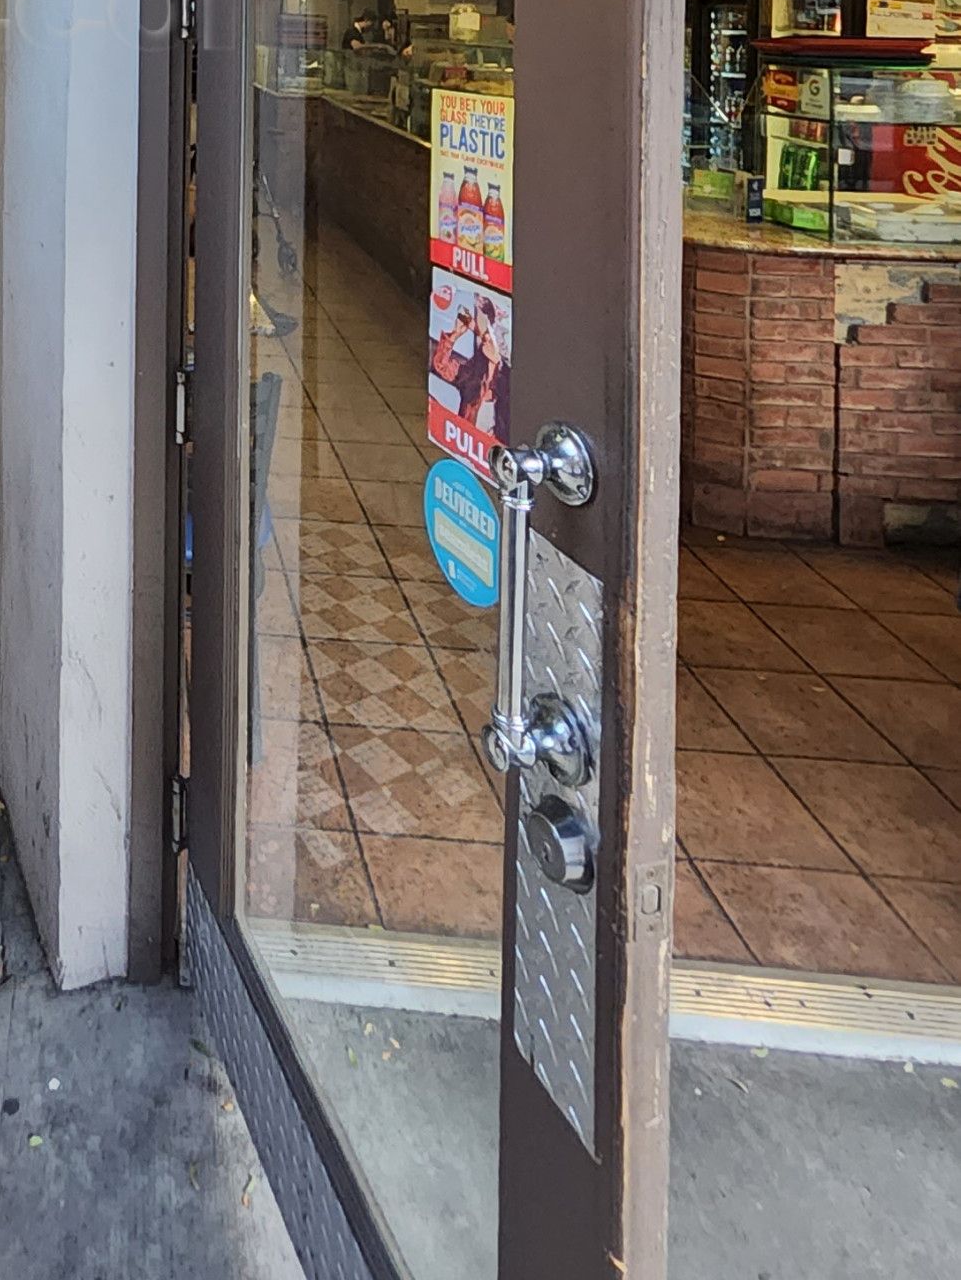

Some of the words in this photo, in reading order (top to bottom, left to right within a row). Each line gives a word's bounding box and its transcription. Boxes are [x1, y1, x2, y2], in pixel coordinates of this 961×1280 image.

[440, 94, 458, 109] YOU
[459, 97, 477, 113] BET
[479, 99, 506, 116] YOUR
[440, 107, 468, 125] GLASS
[469, 113, 506, 132] THEY'RE
[440, 122, 506, 160] PLASTIC
[452, 247, 489, 282] PULL
[445, 419, 491, 471] PULL
[434, 475, 496, 541] DELIVERED
